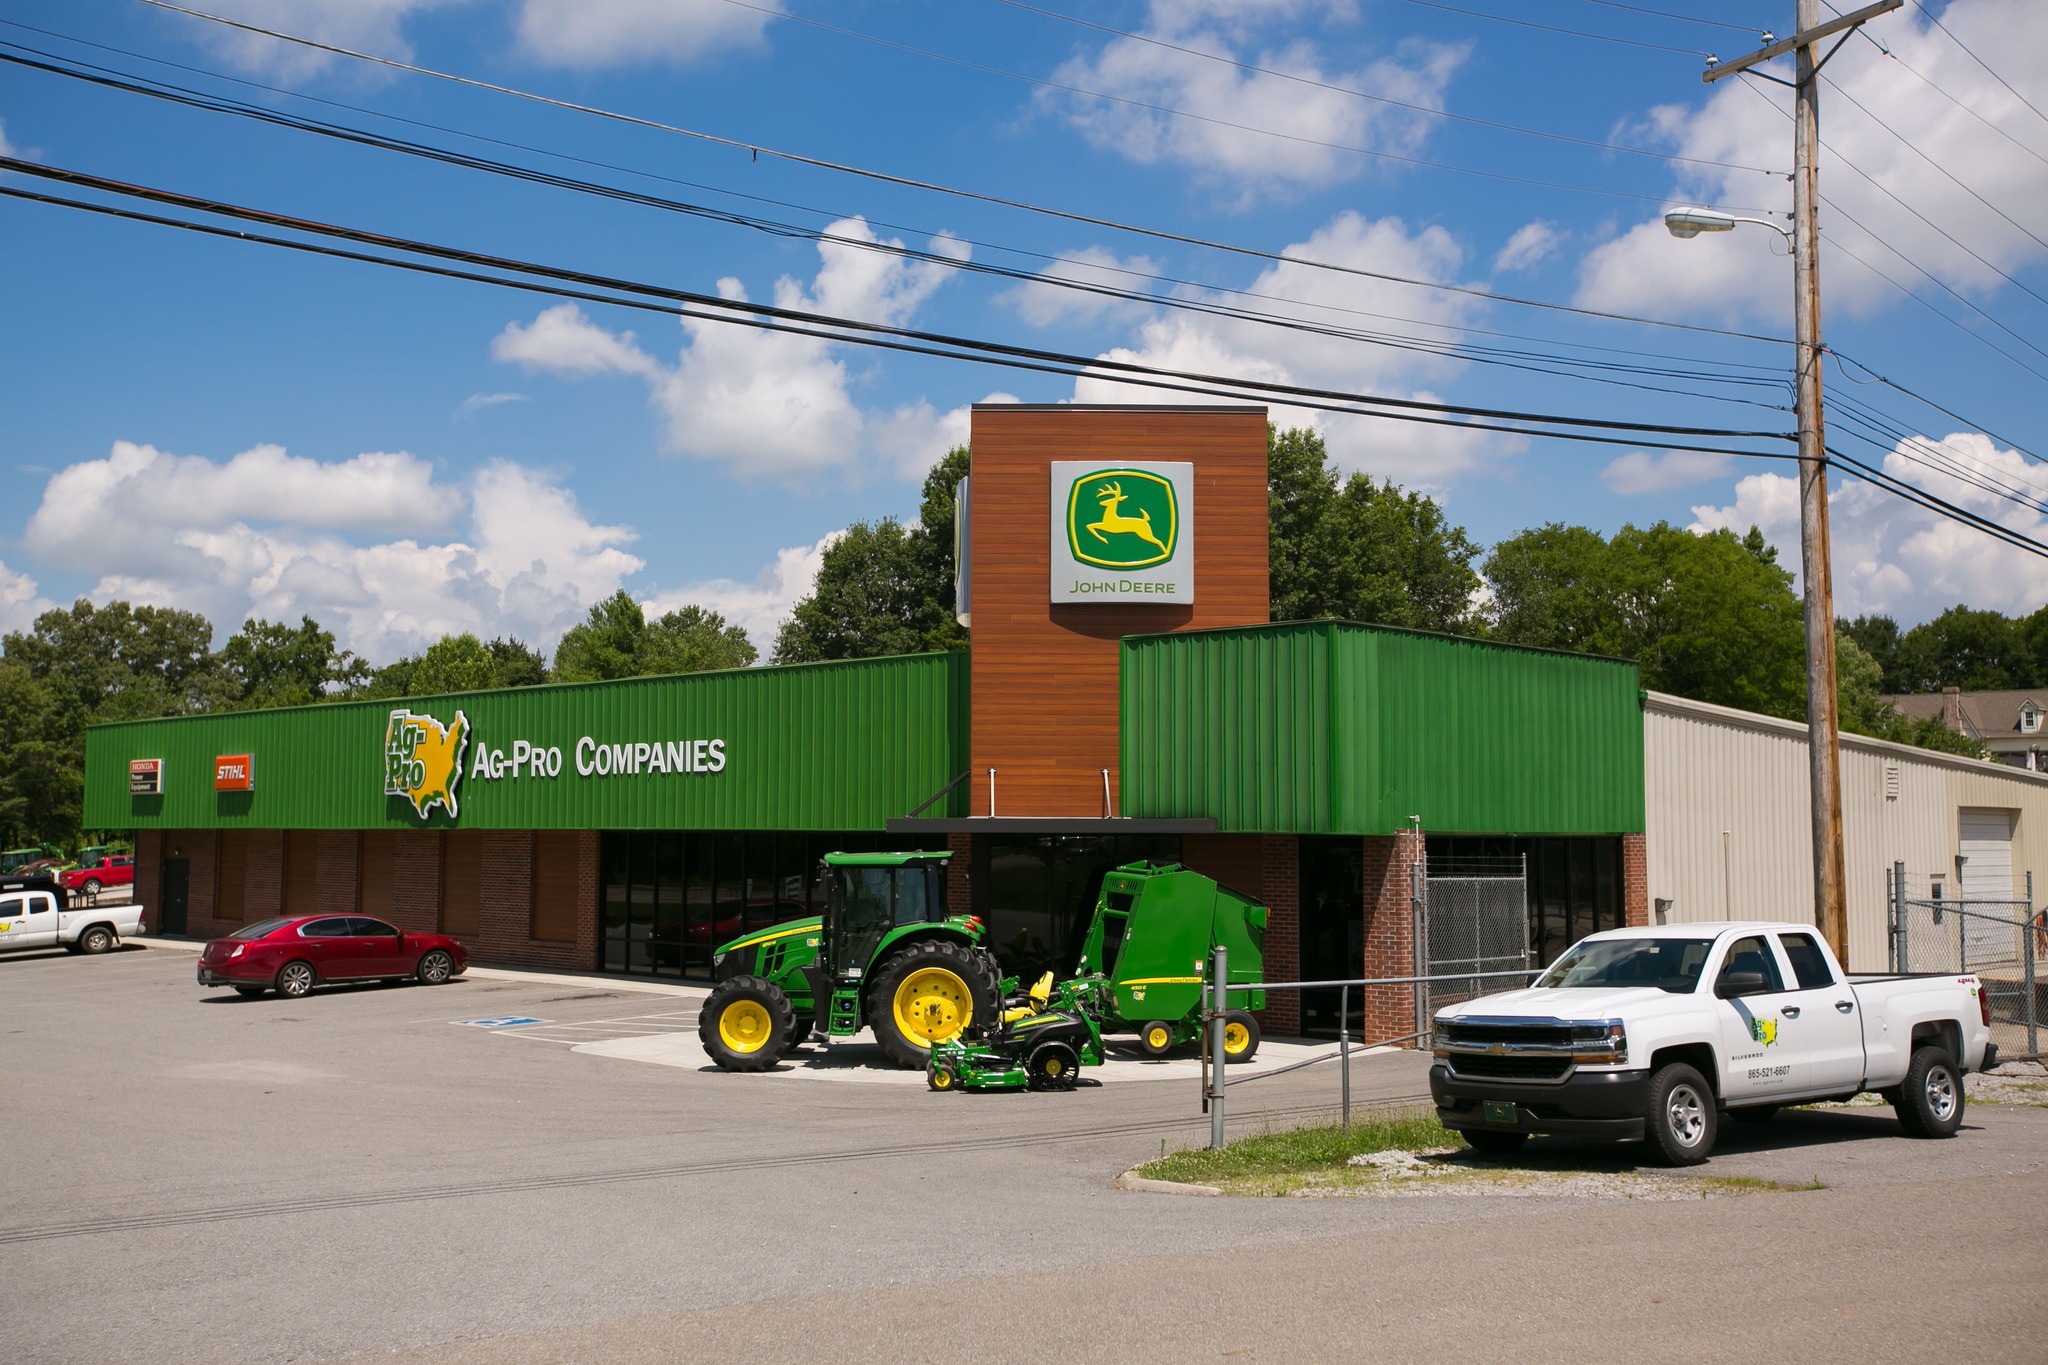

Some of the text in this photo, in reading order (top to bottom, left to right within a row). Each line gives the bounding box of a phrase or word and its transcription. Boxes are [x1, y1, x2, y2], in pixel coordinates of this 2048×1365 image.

[1069, 580, 1176, 594] JOHN DEERE
[386, 713, 427, 760] Ag-
[575, 736, 726, 777] COMPANIES
[132, 762, 154, 771] HONDA
[216, 765, 246, 780] STIHL
[385, 752, 427, 791] Pro
[131, 773, 144, 781] Power
[131, 783, 151, 791] Equipment
[1747, 1065, 1791, 1079] 865-521-6607
